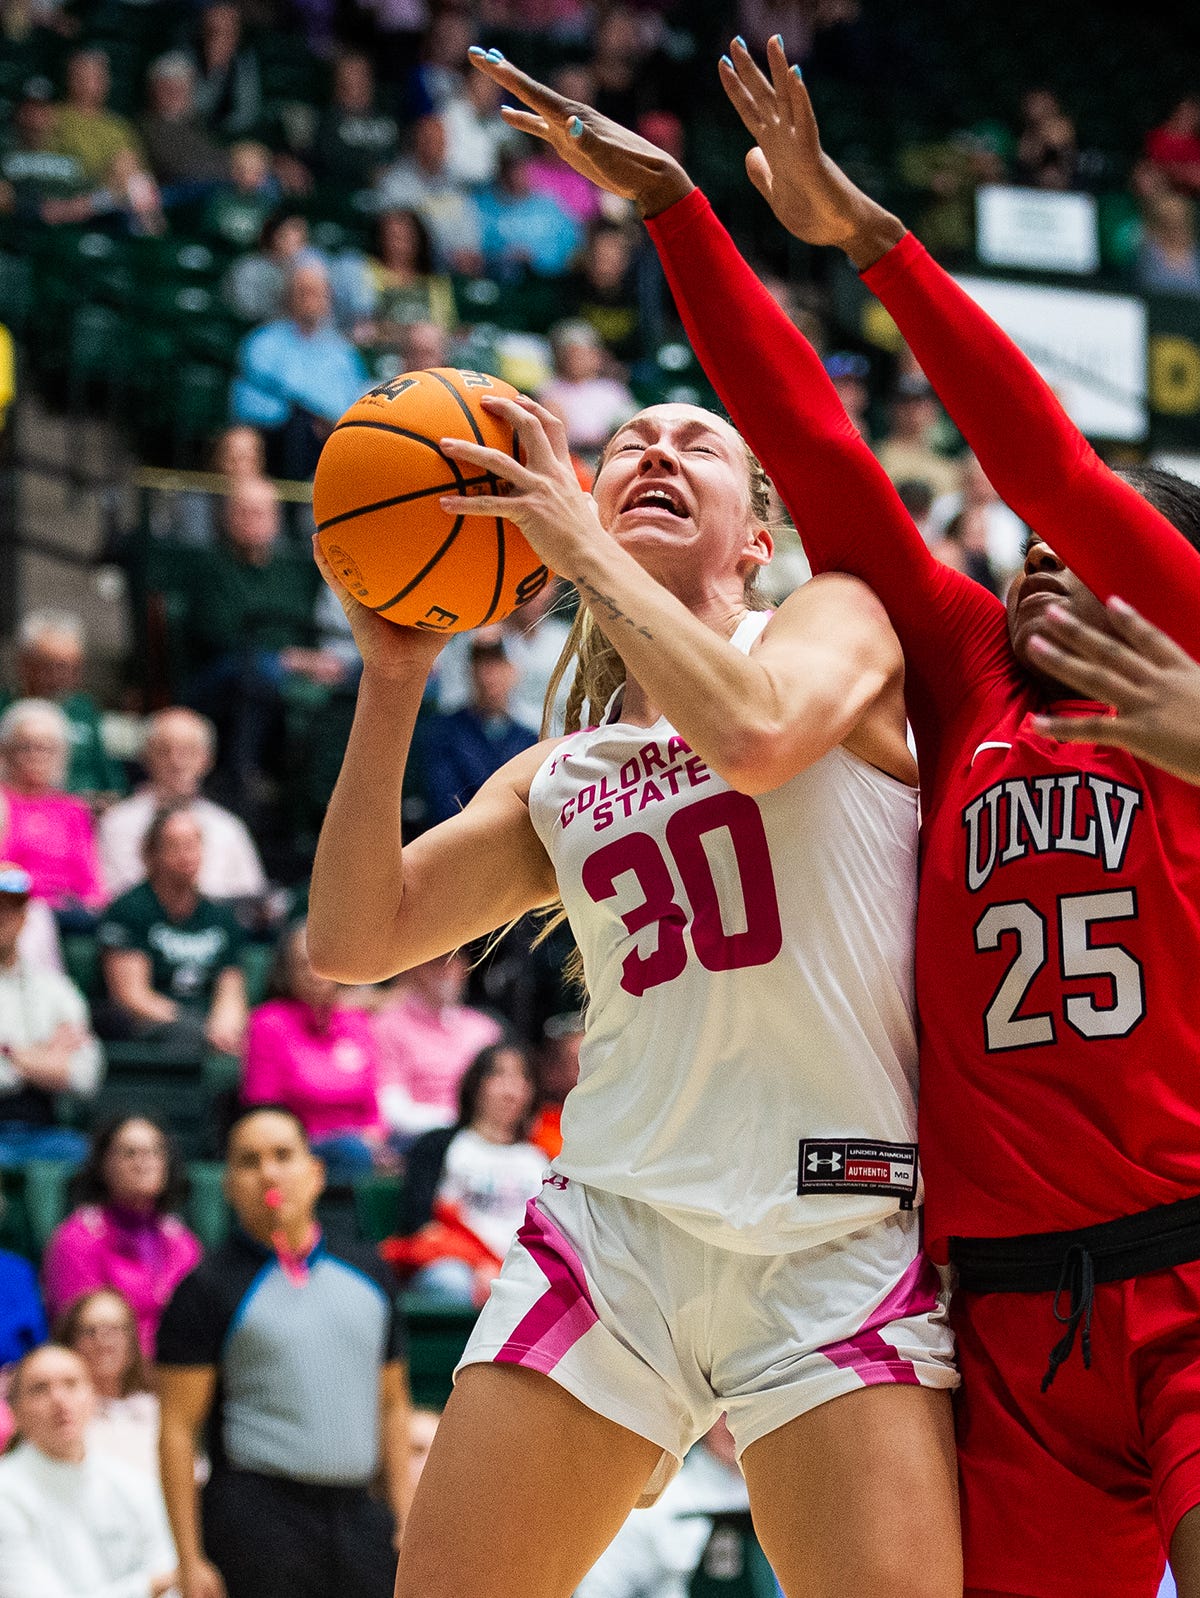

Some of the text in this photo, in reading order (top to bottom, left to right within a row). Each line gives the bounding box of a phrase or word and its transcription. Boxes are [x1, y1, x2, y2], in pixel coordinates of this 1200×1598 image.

[560, 735, 693, 829] COLORA
[593, 755, 711, 832] STATE
[961, 772, 1144, 894] UNLV
[581, 790, 783, 998] 30
[973, 886, 1147, 1054] 25
[848, 1166, 888, 1178] AUTHENTIC
[849, 1149, 912, 1160] UNDER ARMOUR
[894, 1171, 910, 1180] MD
